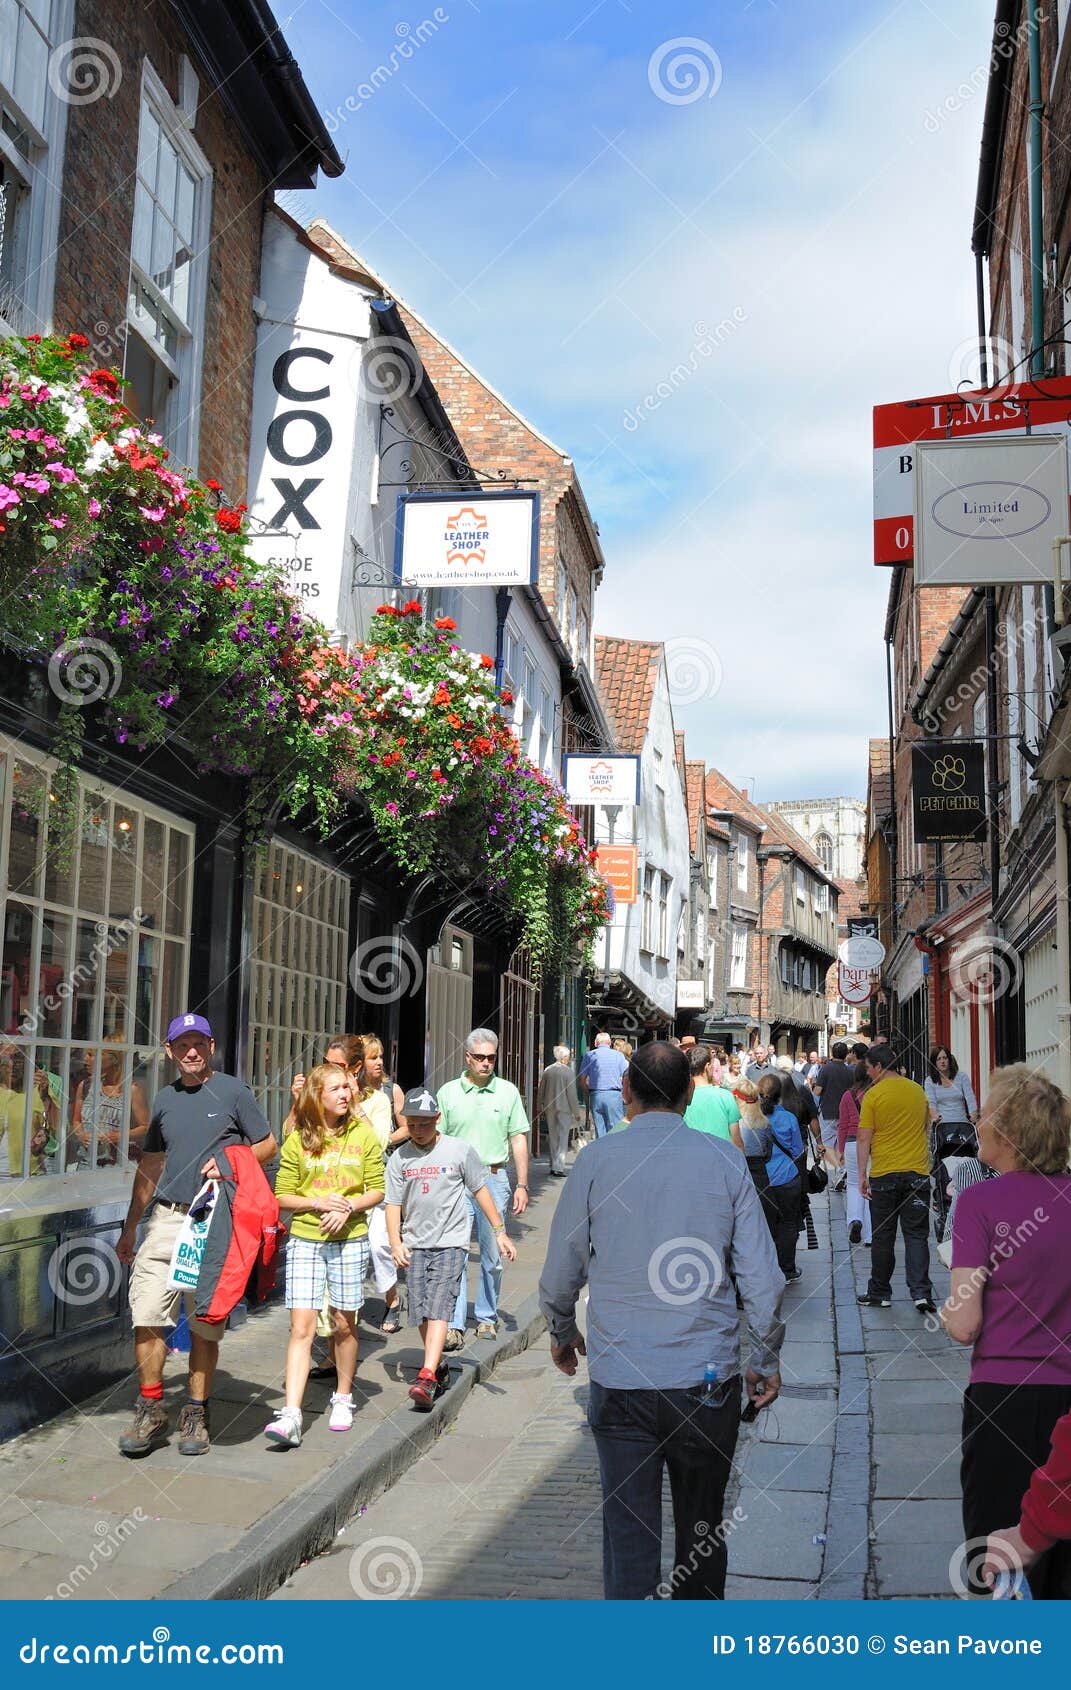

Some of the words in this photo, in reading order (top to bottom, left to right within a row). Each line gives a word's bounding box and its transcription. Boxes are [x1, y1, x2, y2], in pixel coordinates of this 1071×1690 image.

[267, 347, 334, 530] COX
[963, 500, 1019, 514] Limited
[444, 531, 490, 541] LEATHER
[452, 540, 481, 550] SHOP
[919, 796, 945, 812] PET
[946, 795, 980, 811] CHIC
[183, 1015, 195, 1027] B
[401, 1168, 418, 1178] RED
[420, 1166, 440, 1175] SOX
[422, 1182, 430, 1194] B
